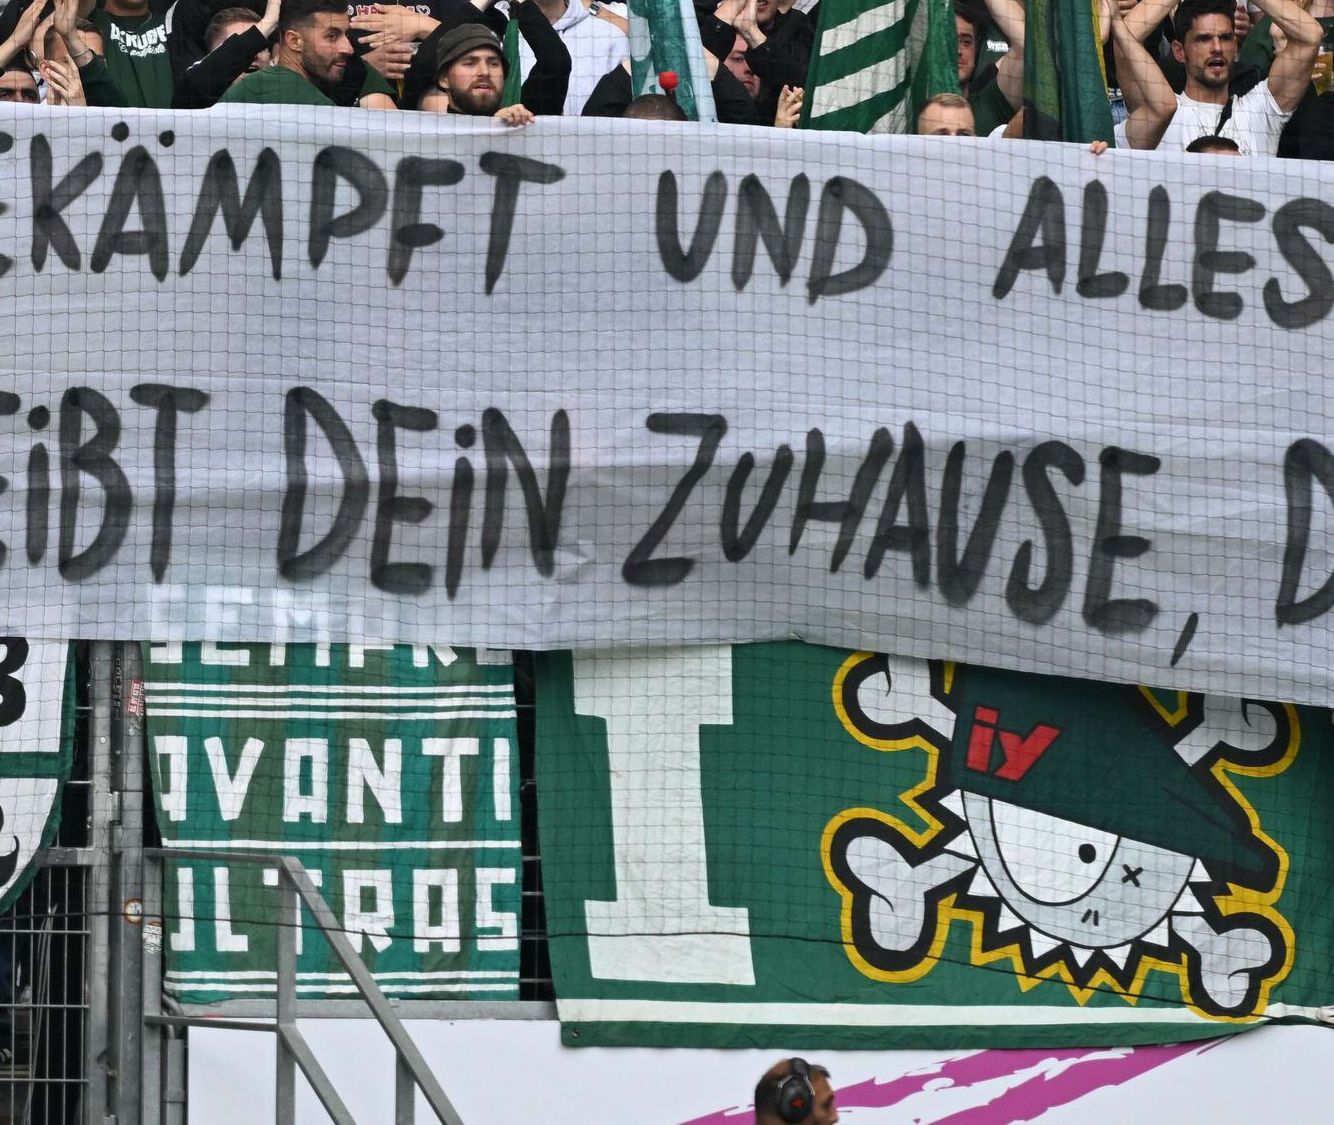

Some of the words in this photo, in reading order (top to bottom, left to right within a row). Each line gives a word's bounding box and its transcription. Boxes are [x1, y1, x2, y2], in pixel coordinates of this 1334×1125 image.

[656, 168, 894, 305] UND
[621, 410, 1199, 668] ZUHAUSE,
[154, 736, 513, 824] AVANTI
